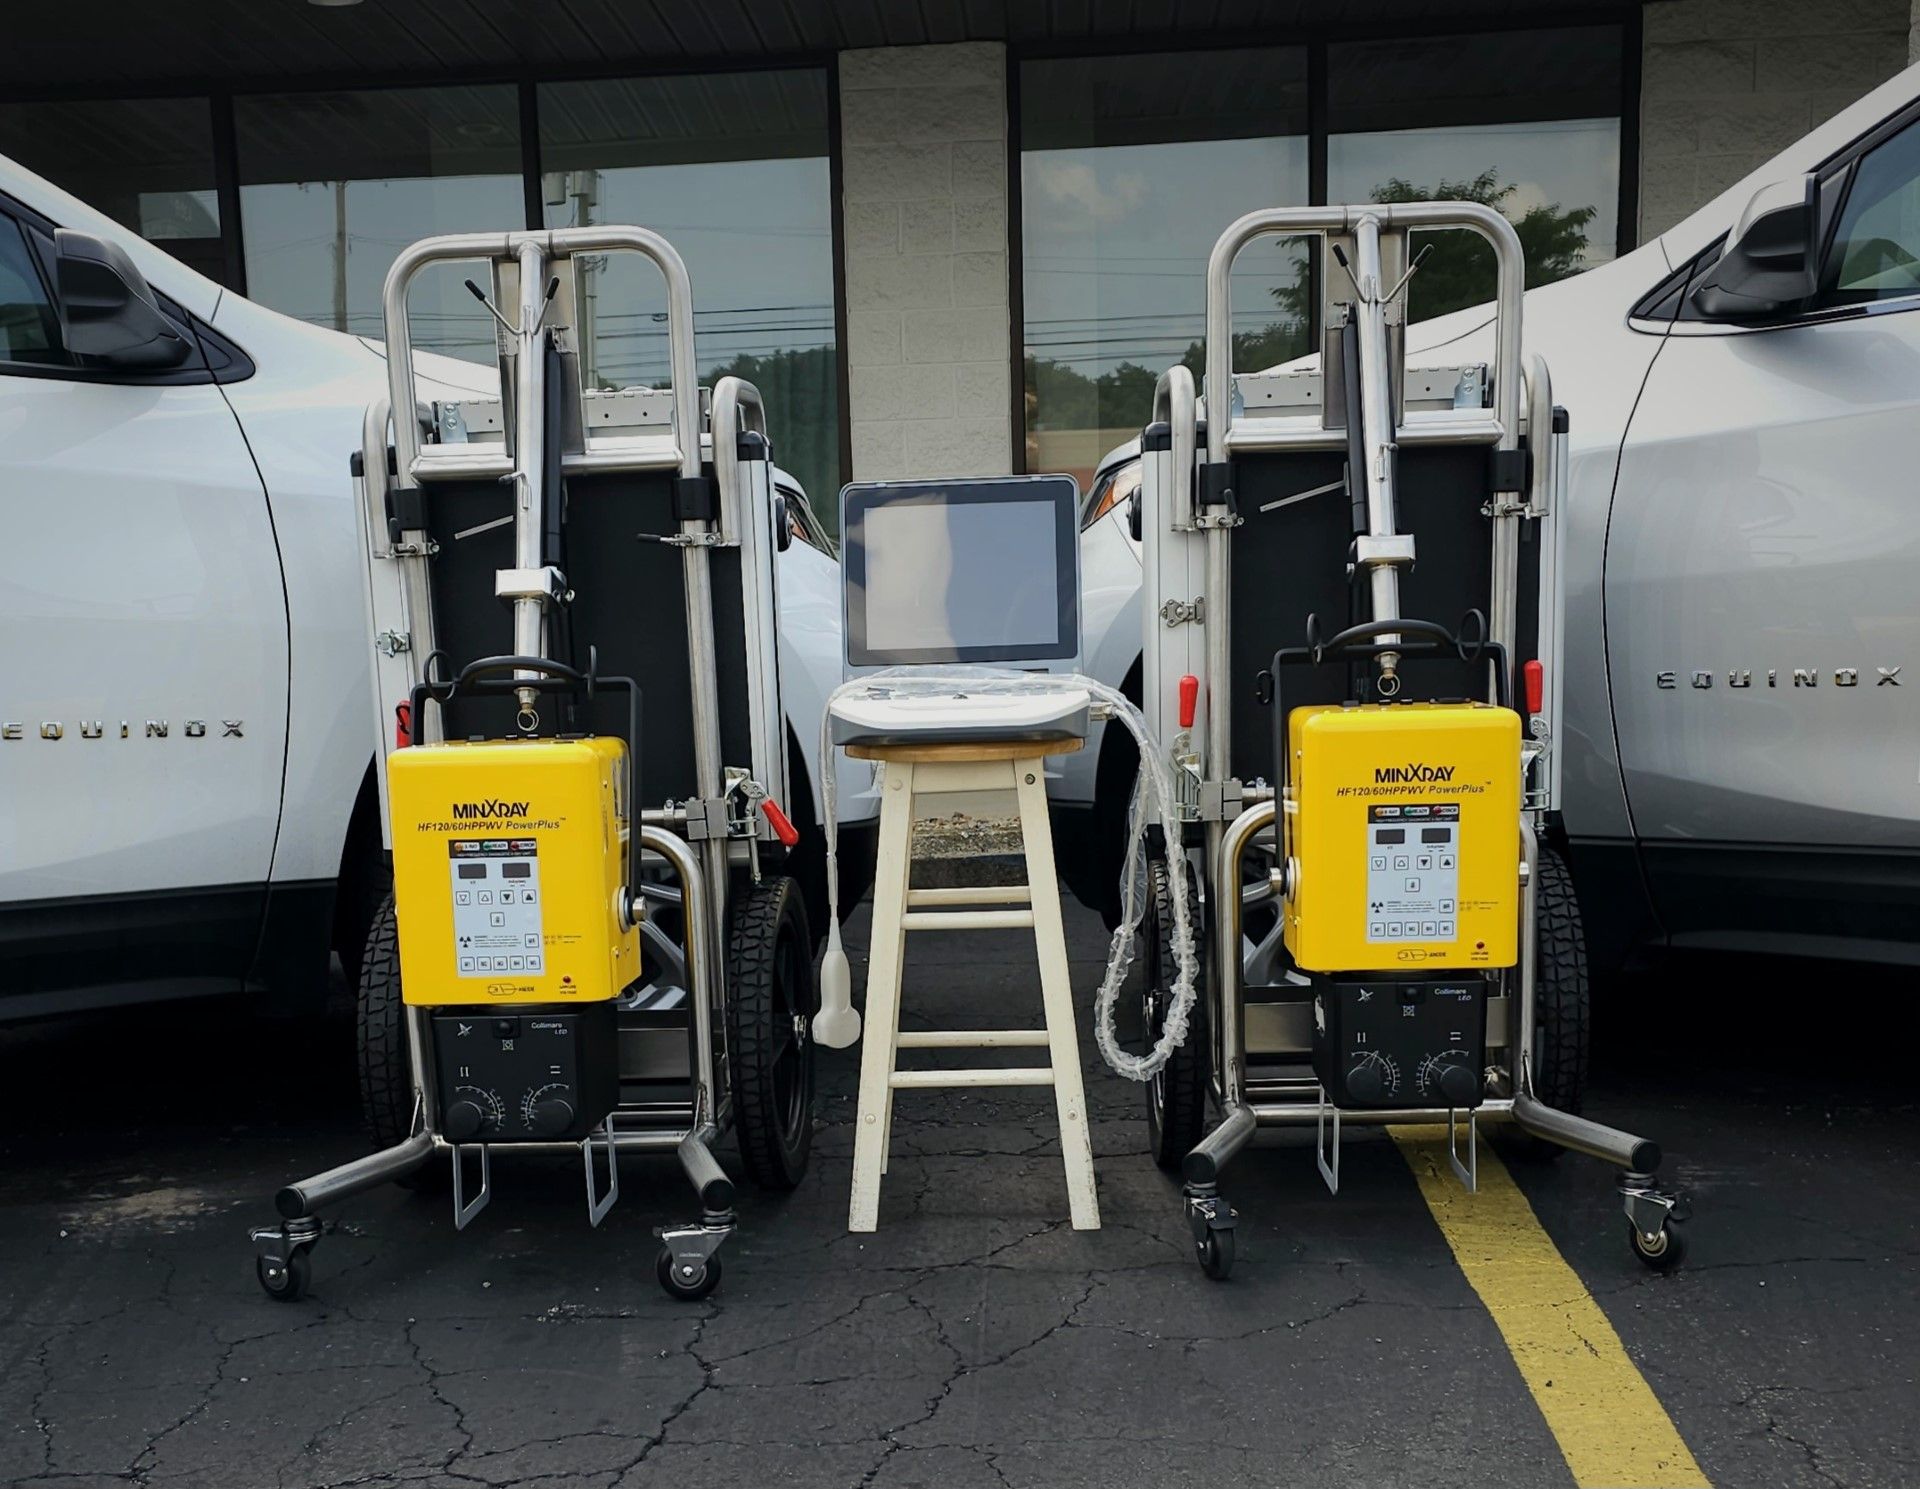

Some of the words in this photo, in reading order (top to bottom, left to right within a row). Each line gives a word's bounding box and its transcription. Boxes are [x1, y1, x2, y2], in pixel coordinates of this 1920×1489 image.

[1656, 665, 1901, 690] EQUINOX
[1, 719, 245, 741] EQUINOX
[1375, 763, 1455, 783] MINXRAY
[1336, 785, 1426, 796] HF120/60HPPWV
[453, 799, 530, 819] MINXRAY
[417, 821, 503, 832] HF120/60HPPWV
